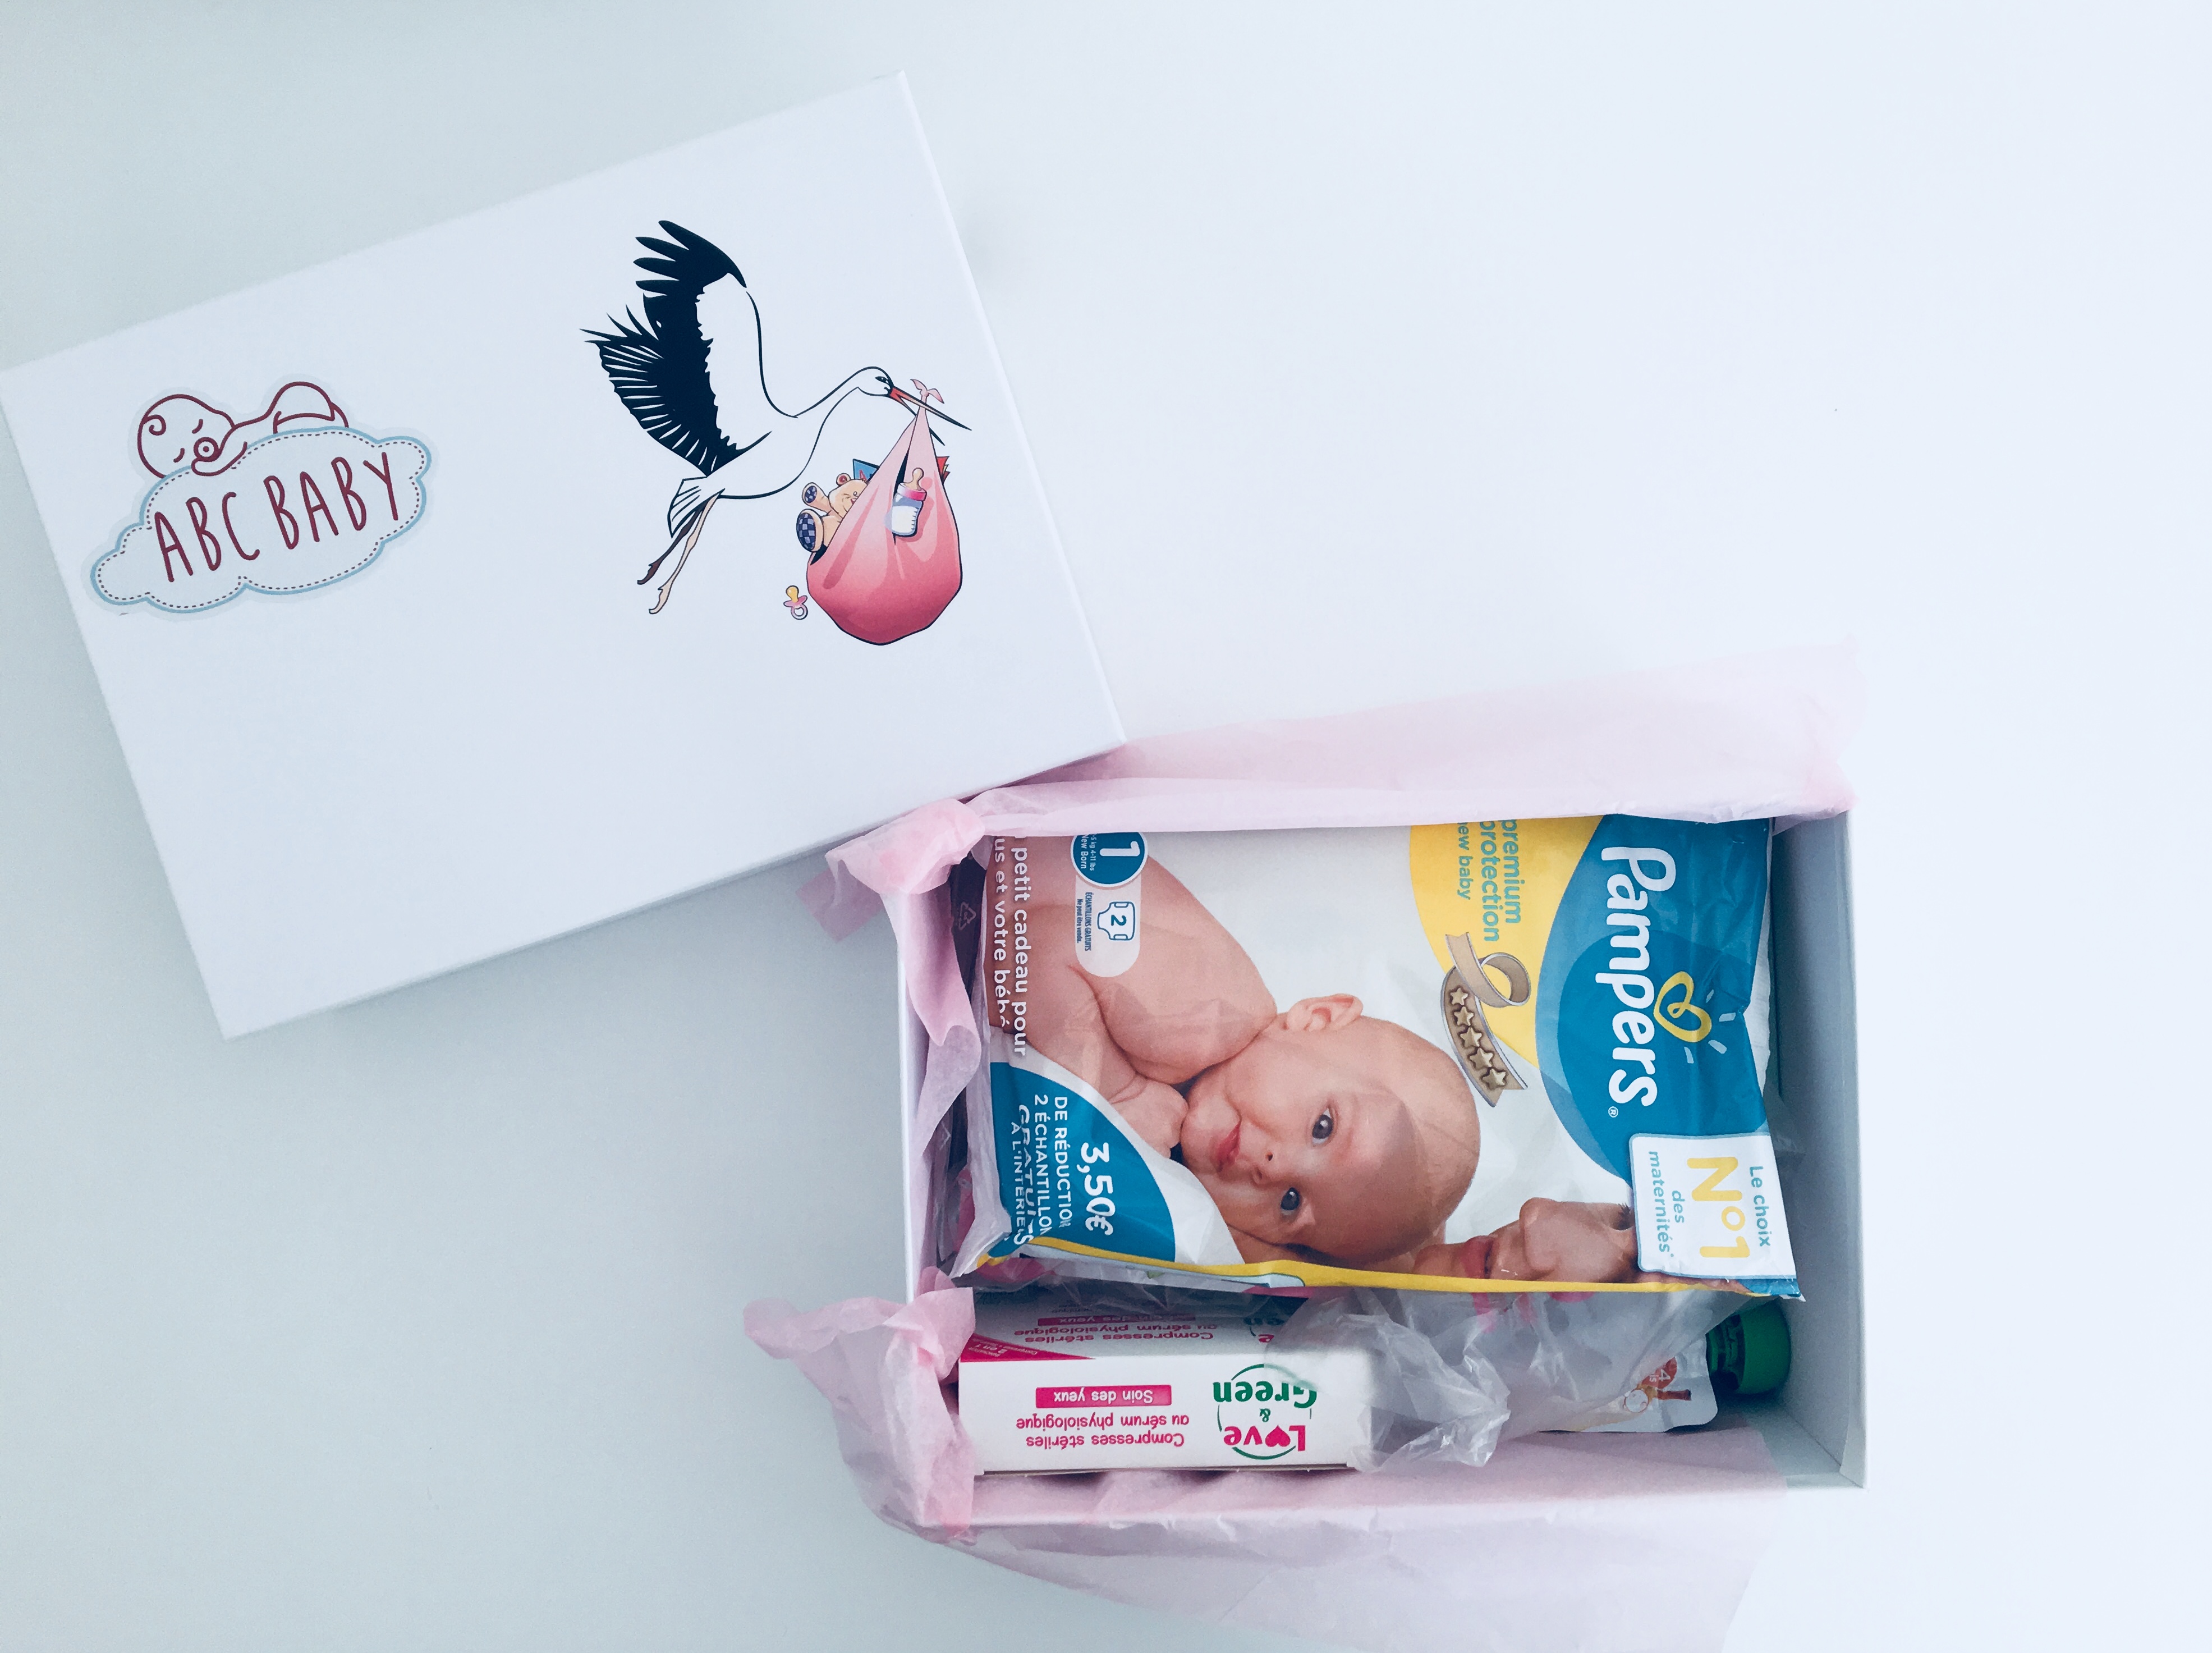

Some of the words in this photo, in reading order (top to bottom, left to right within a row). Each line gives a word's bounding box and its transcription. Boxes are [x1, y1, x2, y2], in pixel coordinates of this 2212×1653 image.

[154, 492, 260, 582] ABC
[263, 452, 398, 550] BABY
[993, 837, 1006, 863] us
[1100, 840, 1140, 857] 1
[994, 871, 1008, 893] et
[1011, 847, 1031, 901] petit
[1457, 856, 1474, 900] baby
[1479, 820, 1503, 941] protection
[1501, 819, 1525, 923] premium
[1085, 892, 1094, 927] ÉCHANTILLONS
[1111, 915, 1127, 926] 2
[994, 901, 1009, 961] votre
[1014, 909, 1031, 993] cadeau
[1595, 846, 1677, 1107] Pampers
[1011, 1001, 1027, 1056] pour
[1035, 1094, 1048, 1105] 2
[1054, 1096, 1068, 1121] DE
[1750, 1166, 1764, 1188] Le
[1077, 1142, 1116, 1235] 3,50€
[1672, 1190, 1686, 1223] des
[1754, 1194, 1772, 1247] choix
[1014, 1324, 1129, 1336] physiologique
[1025, 1333, 1094, 1343] stériles
[1102, 1332, 1214, 1340] Compresses
[1659, 1369, 1671, 1382] 4
[1054, 1387, 1085, 1402] yeux
[1091, 1390, 1117, 1404] des
[1122, 1389, 1153, 1403] Soin
[1213, 1380, 1318, 1408] Green
[1016, 1412, 1114, 1432] physiologique
[1121, 1415, 1167, 1430] sérum
[1172, 1414, 1190, 1425] au
[1259, 1408, 1271, 1422] &
[1026, 1434, 1085, 1450] stériles
[1091, 1431, 1185, 1448] Compresses
